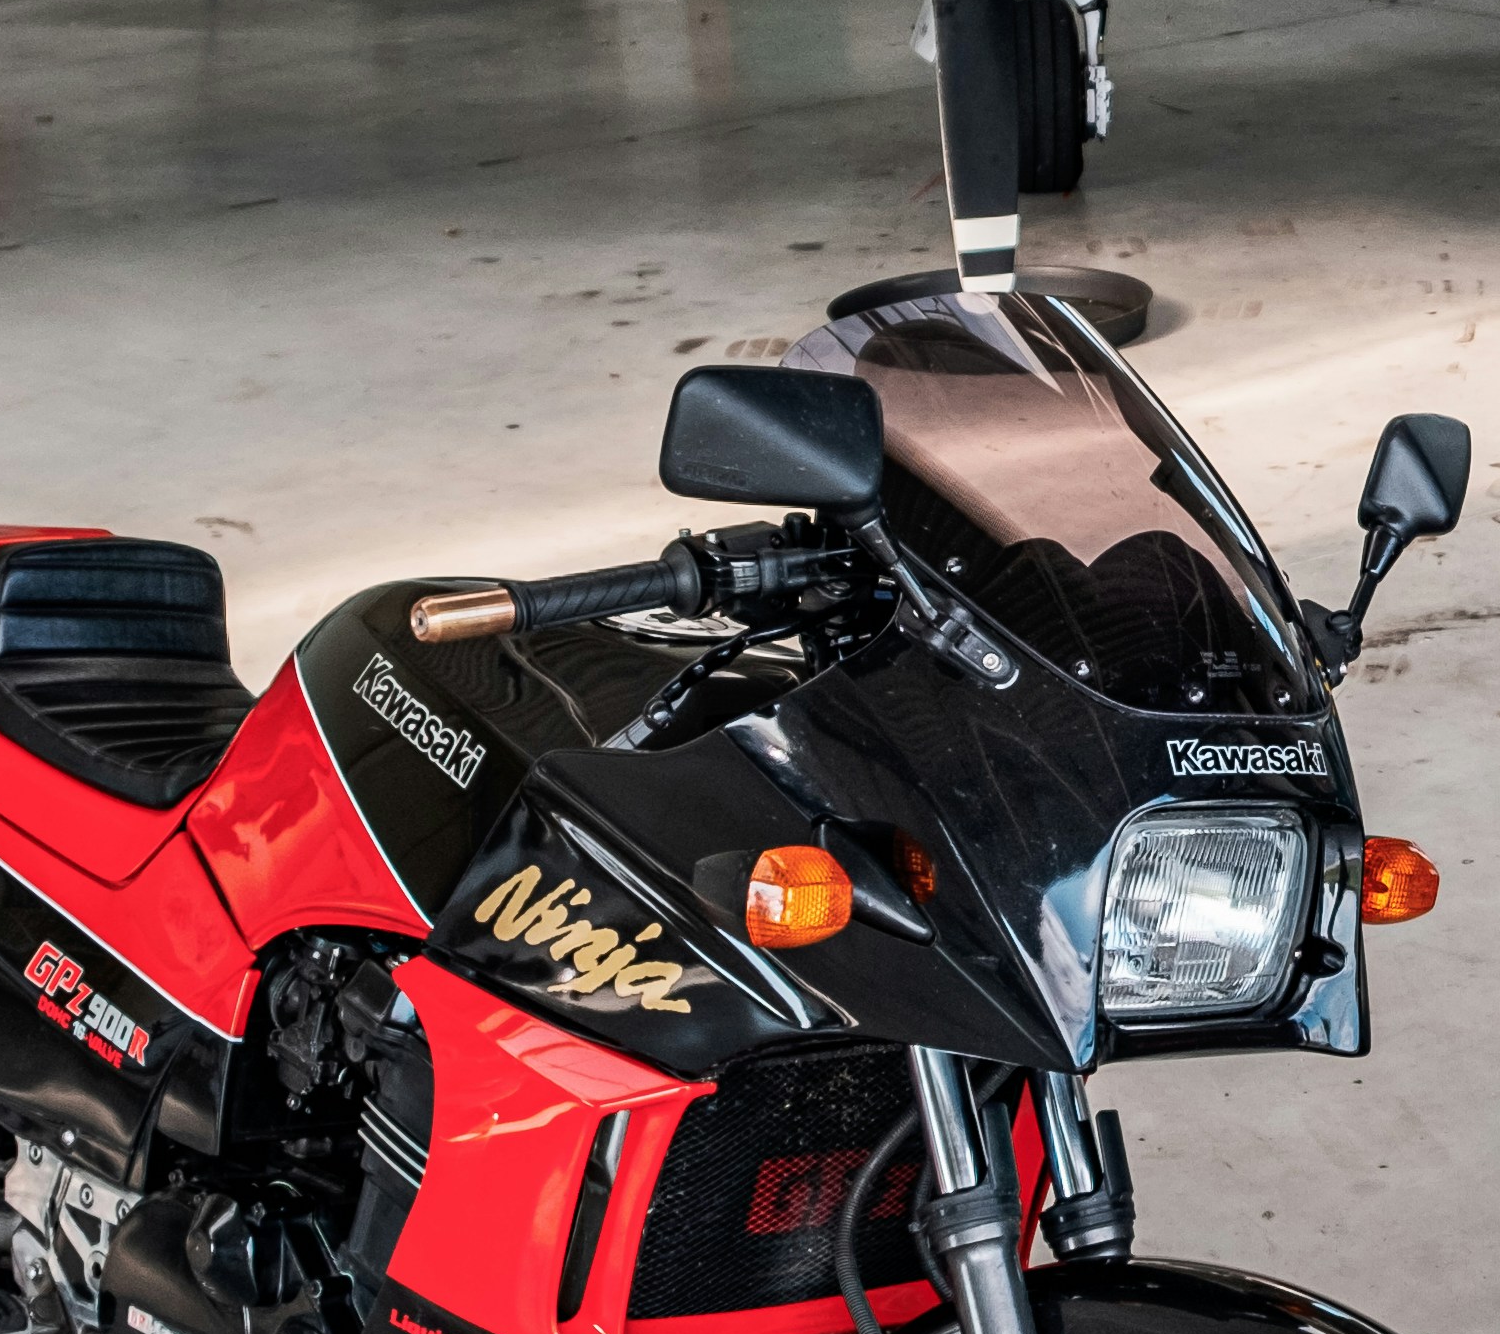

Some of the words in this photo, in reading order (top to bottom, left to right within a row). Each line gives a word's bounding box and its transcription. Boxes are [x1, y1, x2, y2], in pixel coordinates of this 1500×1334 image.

[352, 652, 487, 789] Kawasaki
[1167, 738, 1328, 776] Kawasaki
[474, 865, 692, 1014] Ninja
[37, 994, 72, 1030] DOHC
